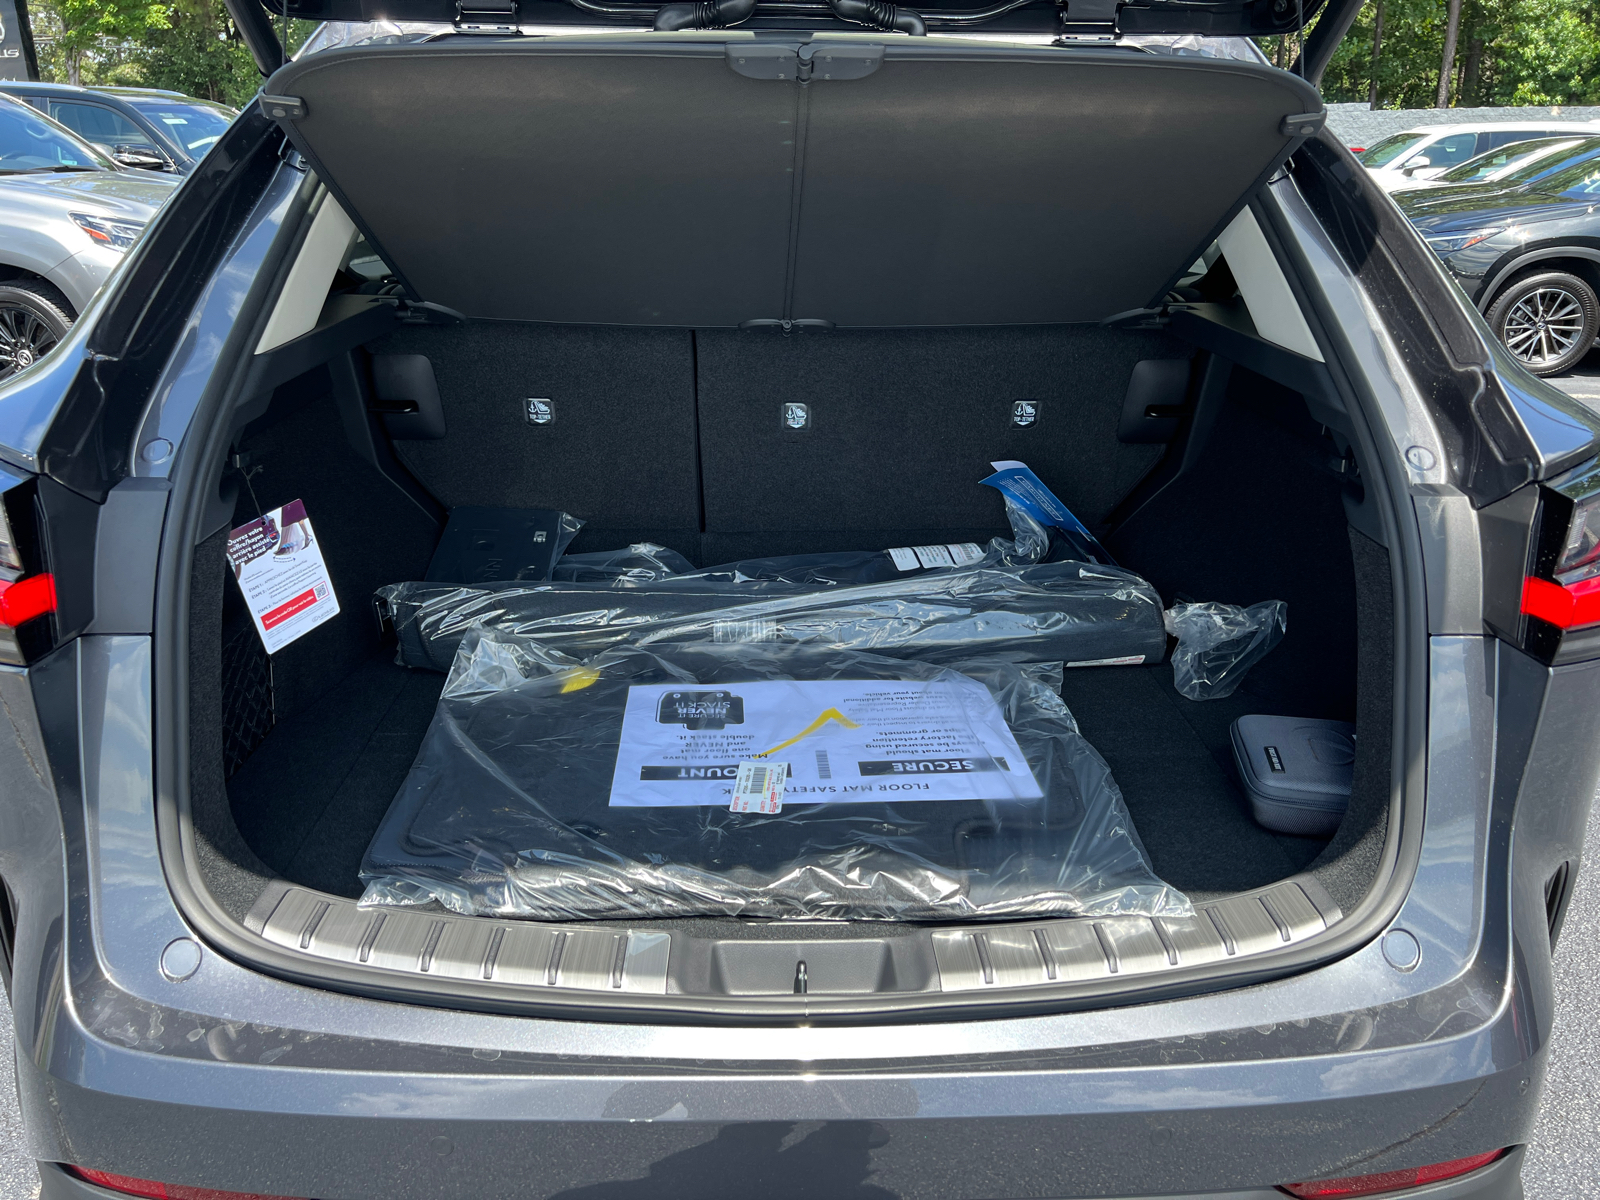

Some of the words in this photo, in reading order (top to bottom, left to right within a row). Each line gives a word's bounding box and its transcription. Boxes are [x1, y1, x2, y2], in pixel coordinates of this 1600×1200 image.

[892, 760, 974, 772] SECURE
[677, 767, 738, 778] OUNT
[783, 786, 837, 794] SAFETY
[842, 785, 872, 793] MAT
[878, 783, 930, 791] FLOOR
